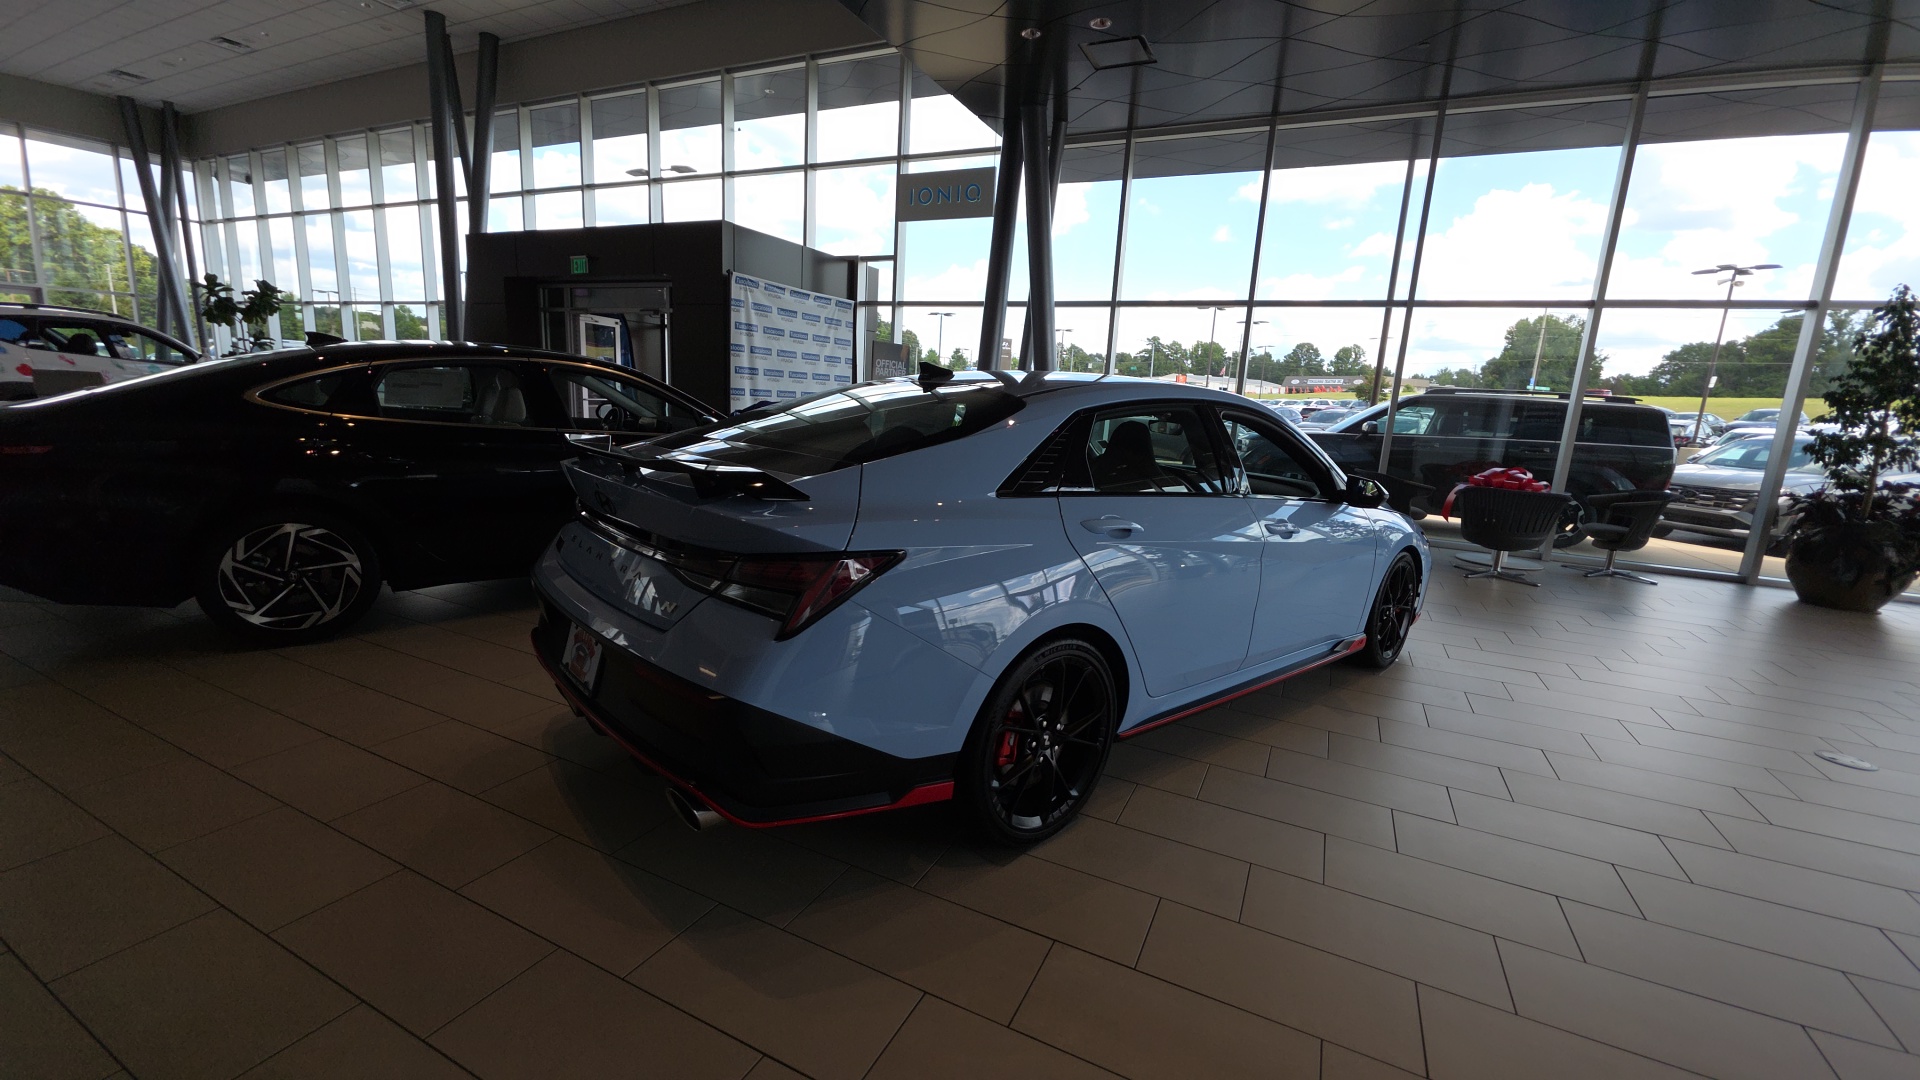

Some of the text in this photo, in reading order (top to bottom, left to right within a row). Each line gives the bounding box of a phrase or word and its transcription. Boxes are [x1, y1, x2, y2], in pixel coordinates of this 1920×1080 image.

[910, 183, 981, 206] IONIQ
[875, 359, 906, 370] OFFICIAL
[875, 367, 906, 377] PARTNER
[572, 534, 678, 614] ELANTRA N
